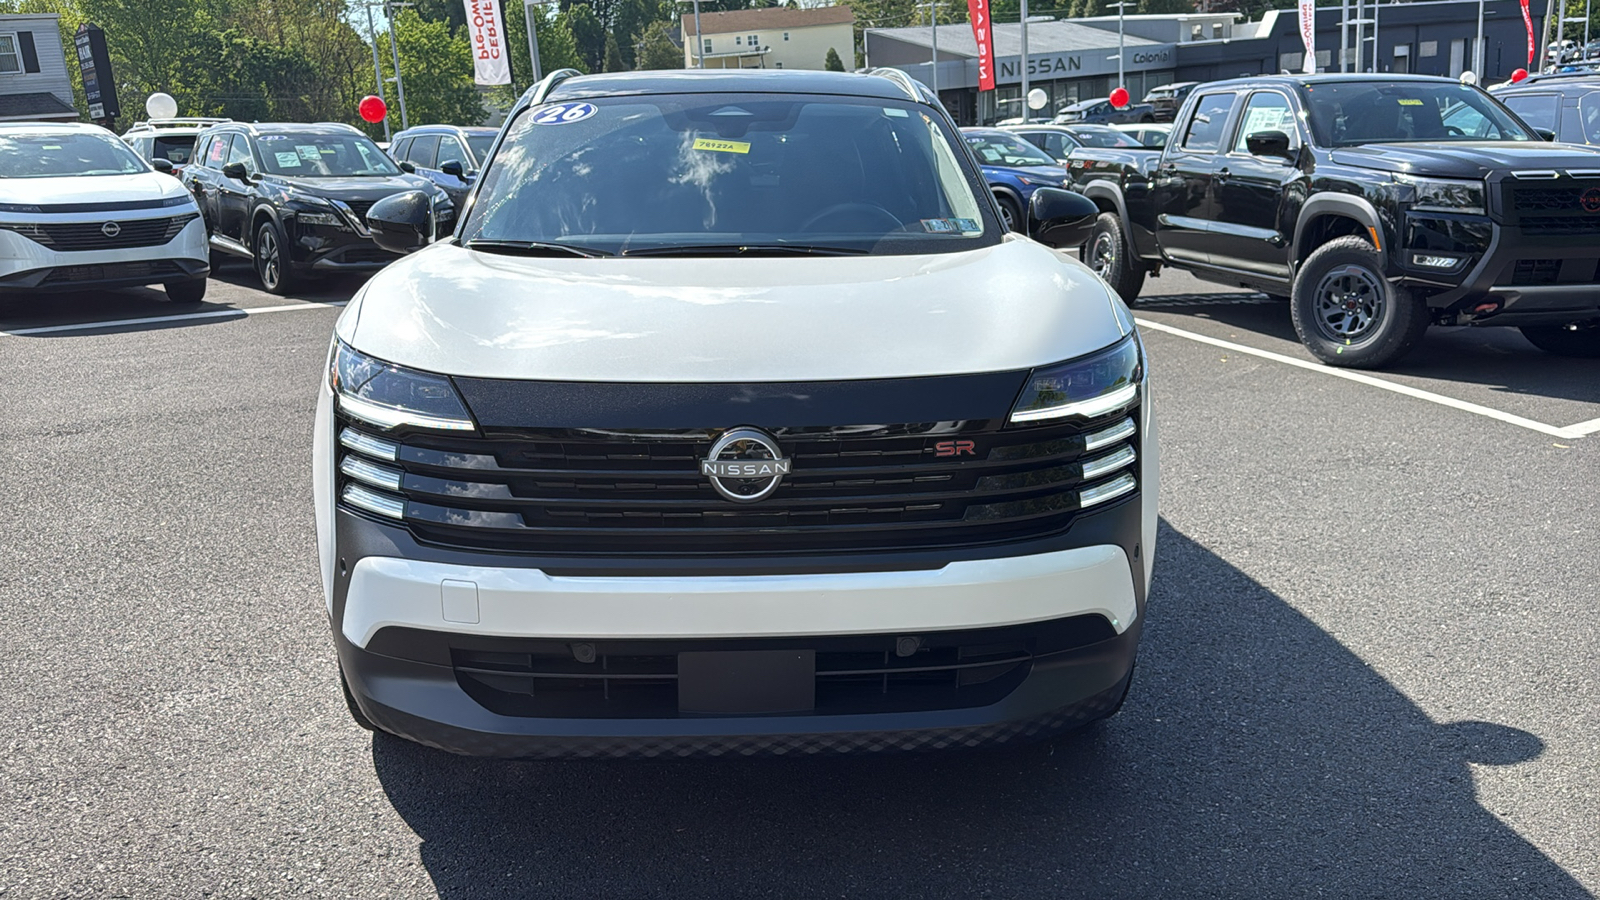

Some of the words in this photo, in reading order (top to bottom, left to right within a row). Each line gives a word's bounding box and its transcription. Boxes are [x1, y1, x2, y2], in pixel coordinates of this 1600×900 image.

[1001, 56, 1081, 77] NISSAN
[1133, 51, 1171, 64] Colonial
[537, 104, 587, 122] 26
[935, 440, 976, 457] SR
[704, 461, 788, 475] NISSAN
